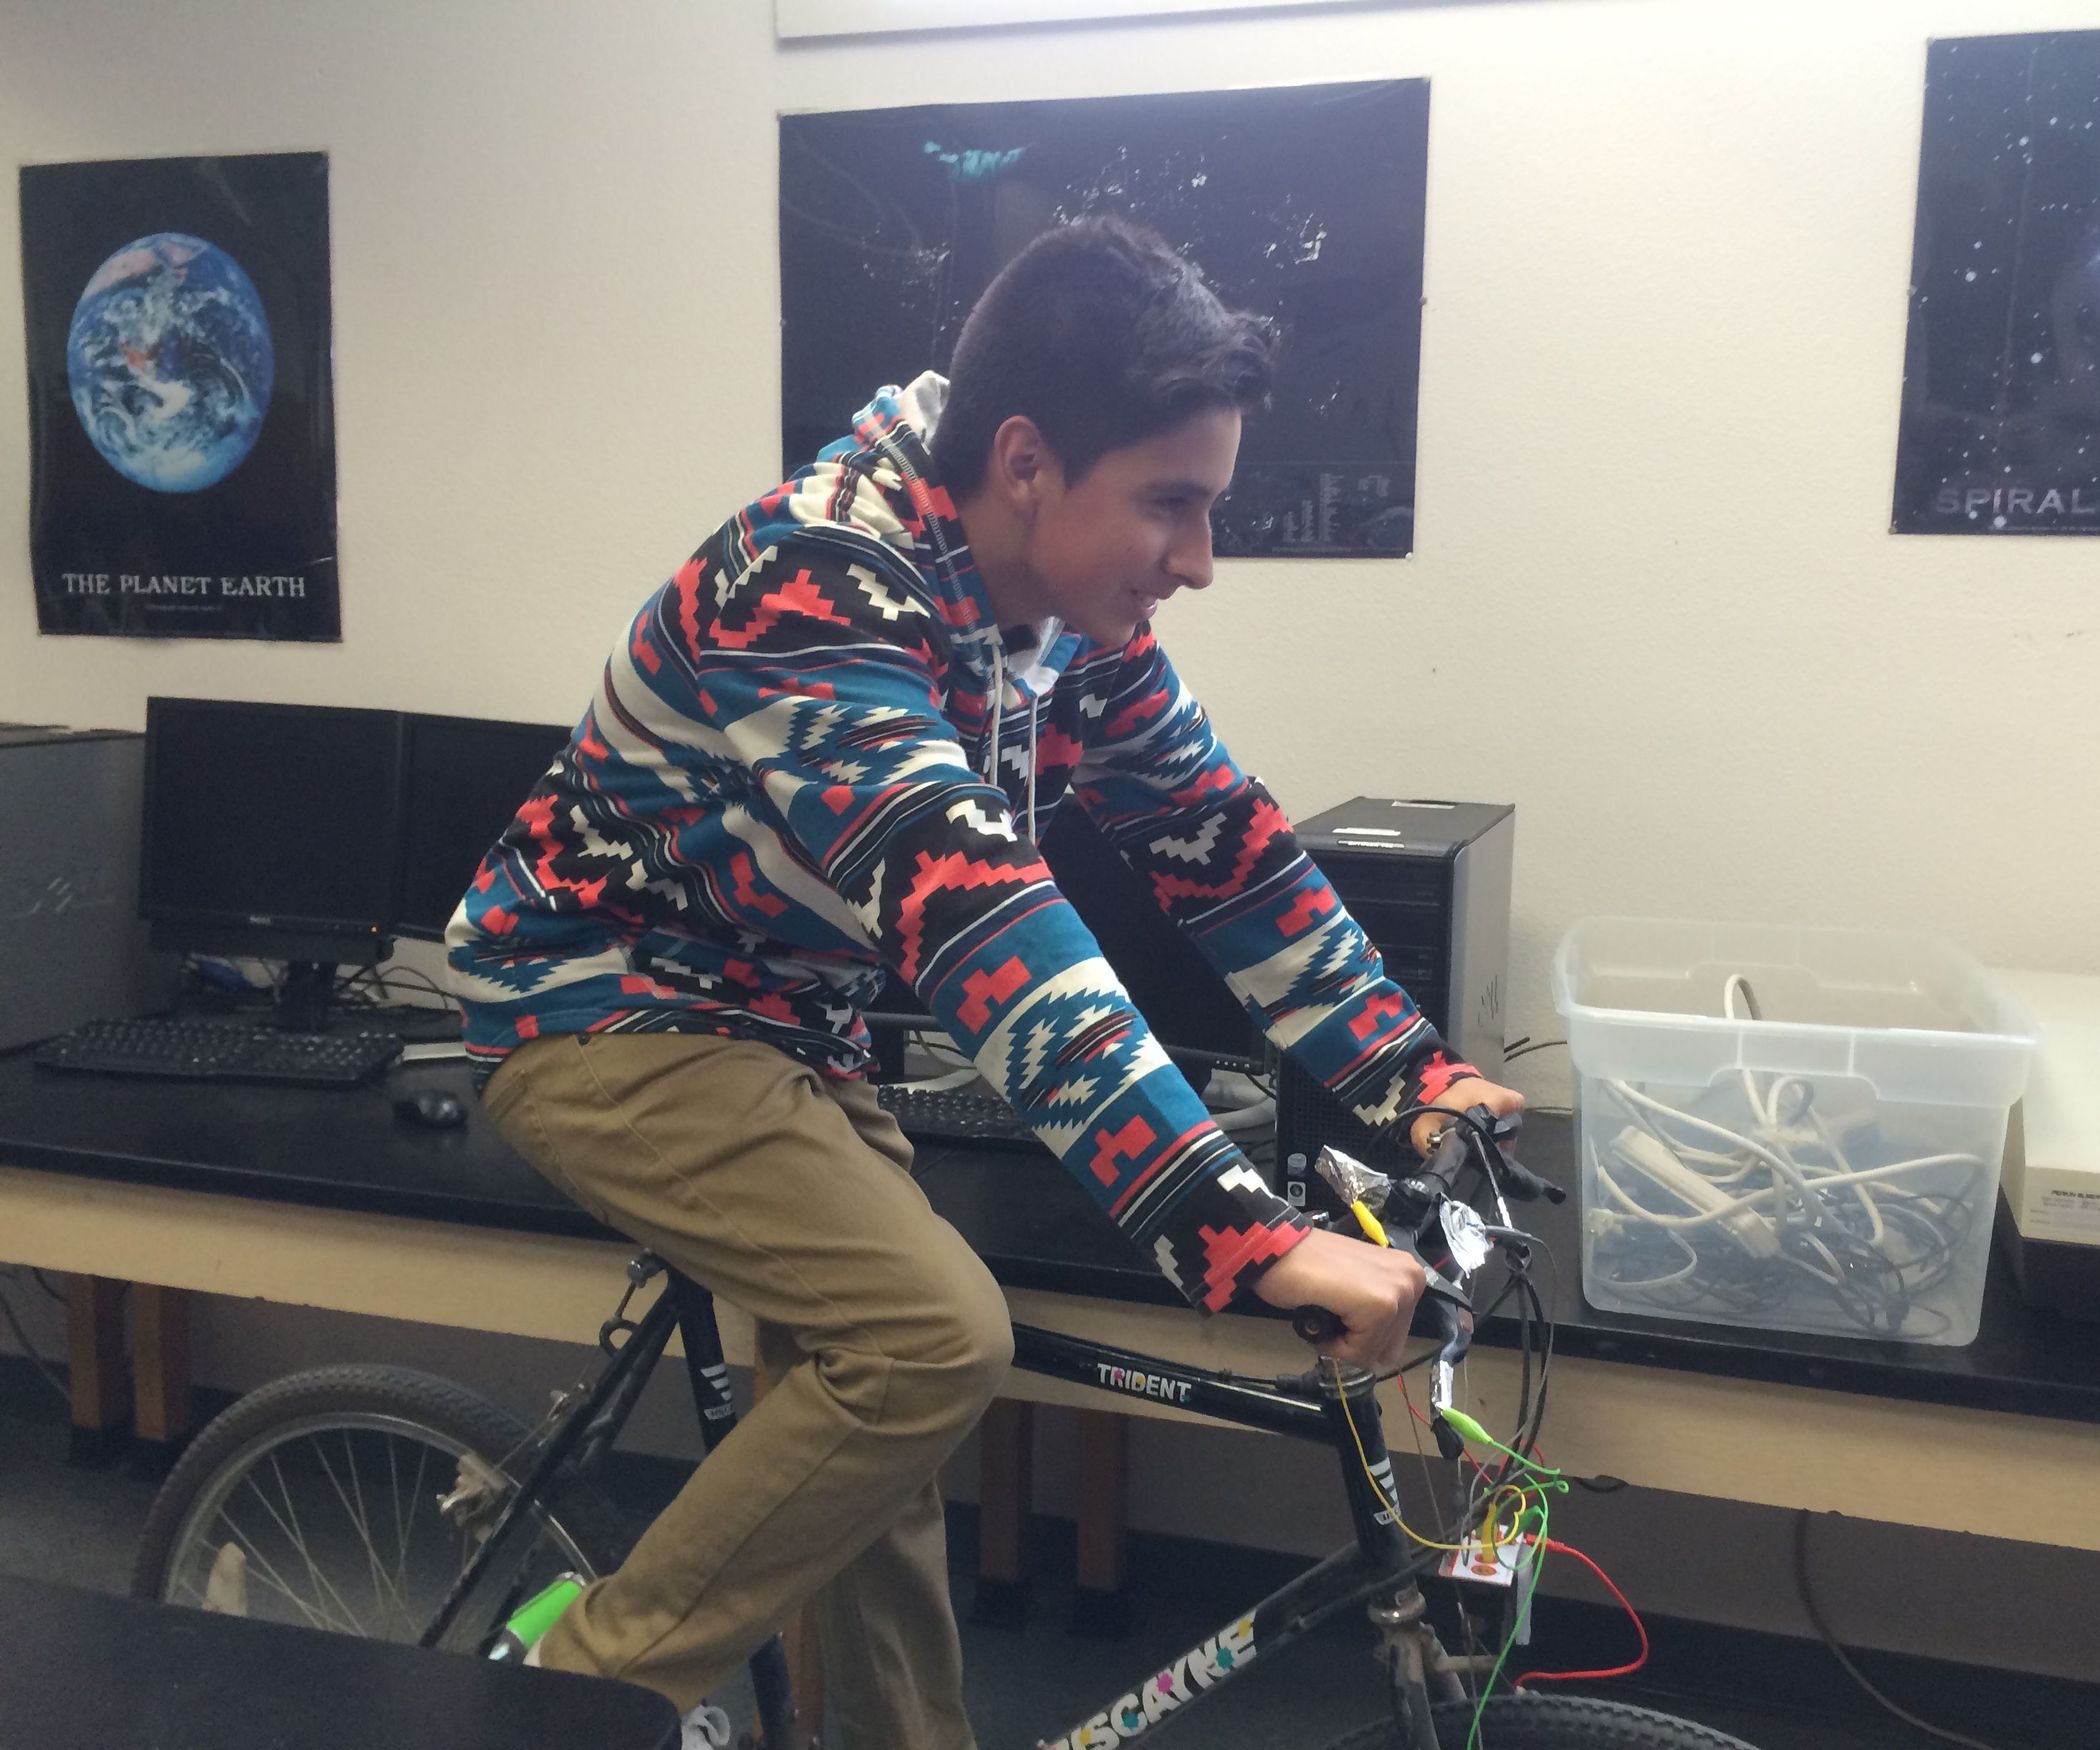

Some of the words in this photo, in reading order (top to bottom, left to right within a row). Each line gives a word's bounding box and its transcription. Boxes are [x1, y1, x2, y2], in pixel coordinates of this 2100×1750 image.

[1936, 487, 2097, 515] SPIRAL
[61, 573, 111, 596] THE
[120, 573, 212, 596] PLANET
[221, 576, 306, 598] EARTH
[1097, 1362, 1192, 1403] TRIDENT
[1037, 1609, 1258, 1750] SCAYNE
